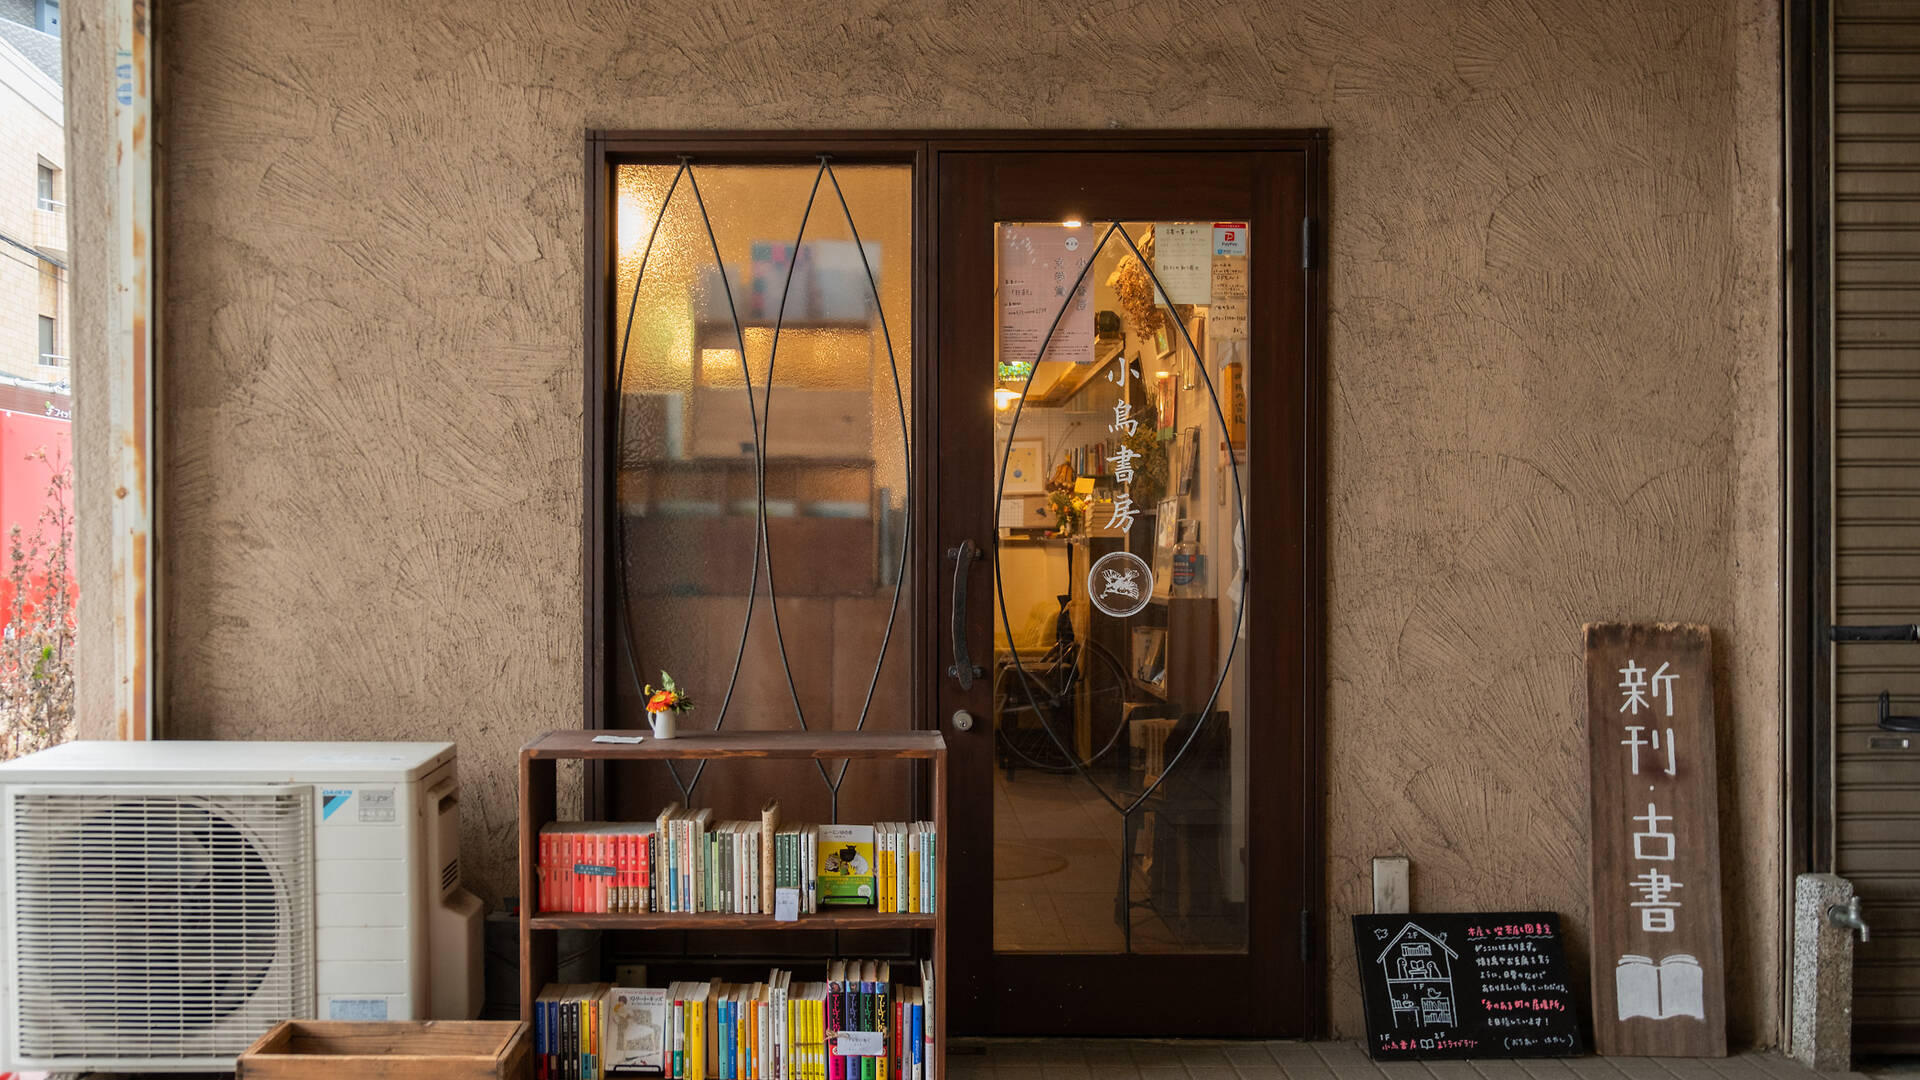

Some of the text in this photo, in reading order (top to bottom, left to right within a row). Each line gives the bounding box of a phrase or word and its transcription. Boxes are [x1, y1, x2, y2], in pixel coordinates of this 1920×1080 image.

[1104, 357, 1142, 534] 小鳥書房
[1619, 659, 1684, 932] 新刊・古書
[1413, 983, 1424, 991] 1F
[1380, 1033, 1390, 1041] 1F
[1434, 1032, 1446, 1040] 2F
